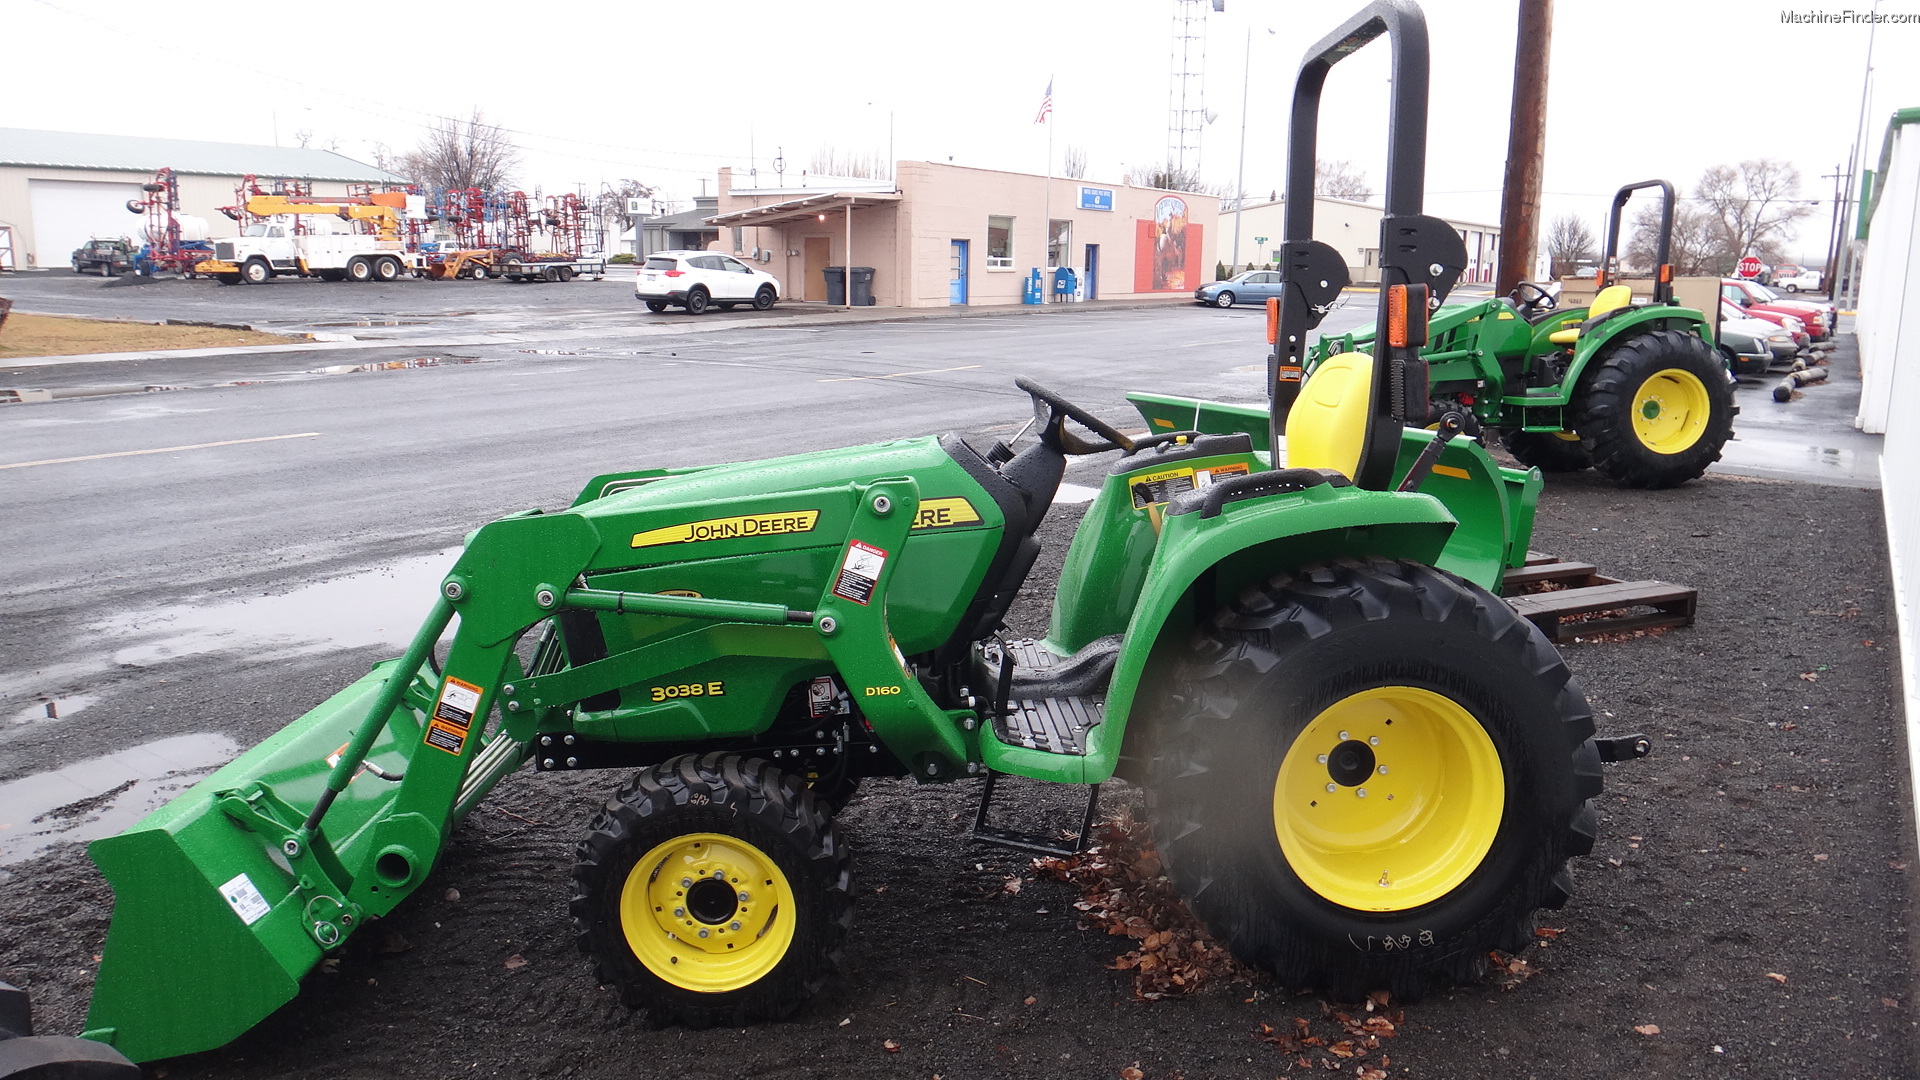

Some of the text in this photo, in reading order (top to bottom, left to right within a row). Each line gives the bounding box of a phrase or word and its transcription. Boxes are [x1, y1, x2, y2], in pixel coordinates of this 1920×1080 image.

[1740, 262, 1761, 272] STOP
[1220, 465, 1243, 473] WARNING
[1152, 471, 1179, 482] CAUTION
[684, 516, 809, 541] JOHN DEERE
[862, 544, 884, 556] DANGER
[456, 681, 479, 692] WARNING
[651, 681, 724, 702] 3038 E
[865, 685, 901, 697] D160
[440, 725, 463, 736] WARNING
